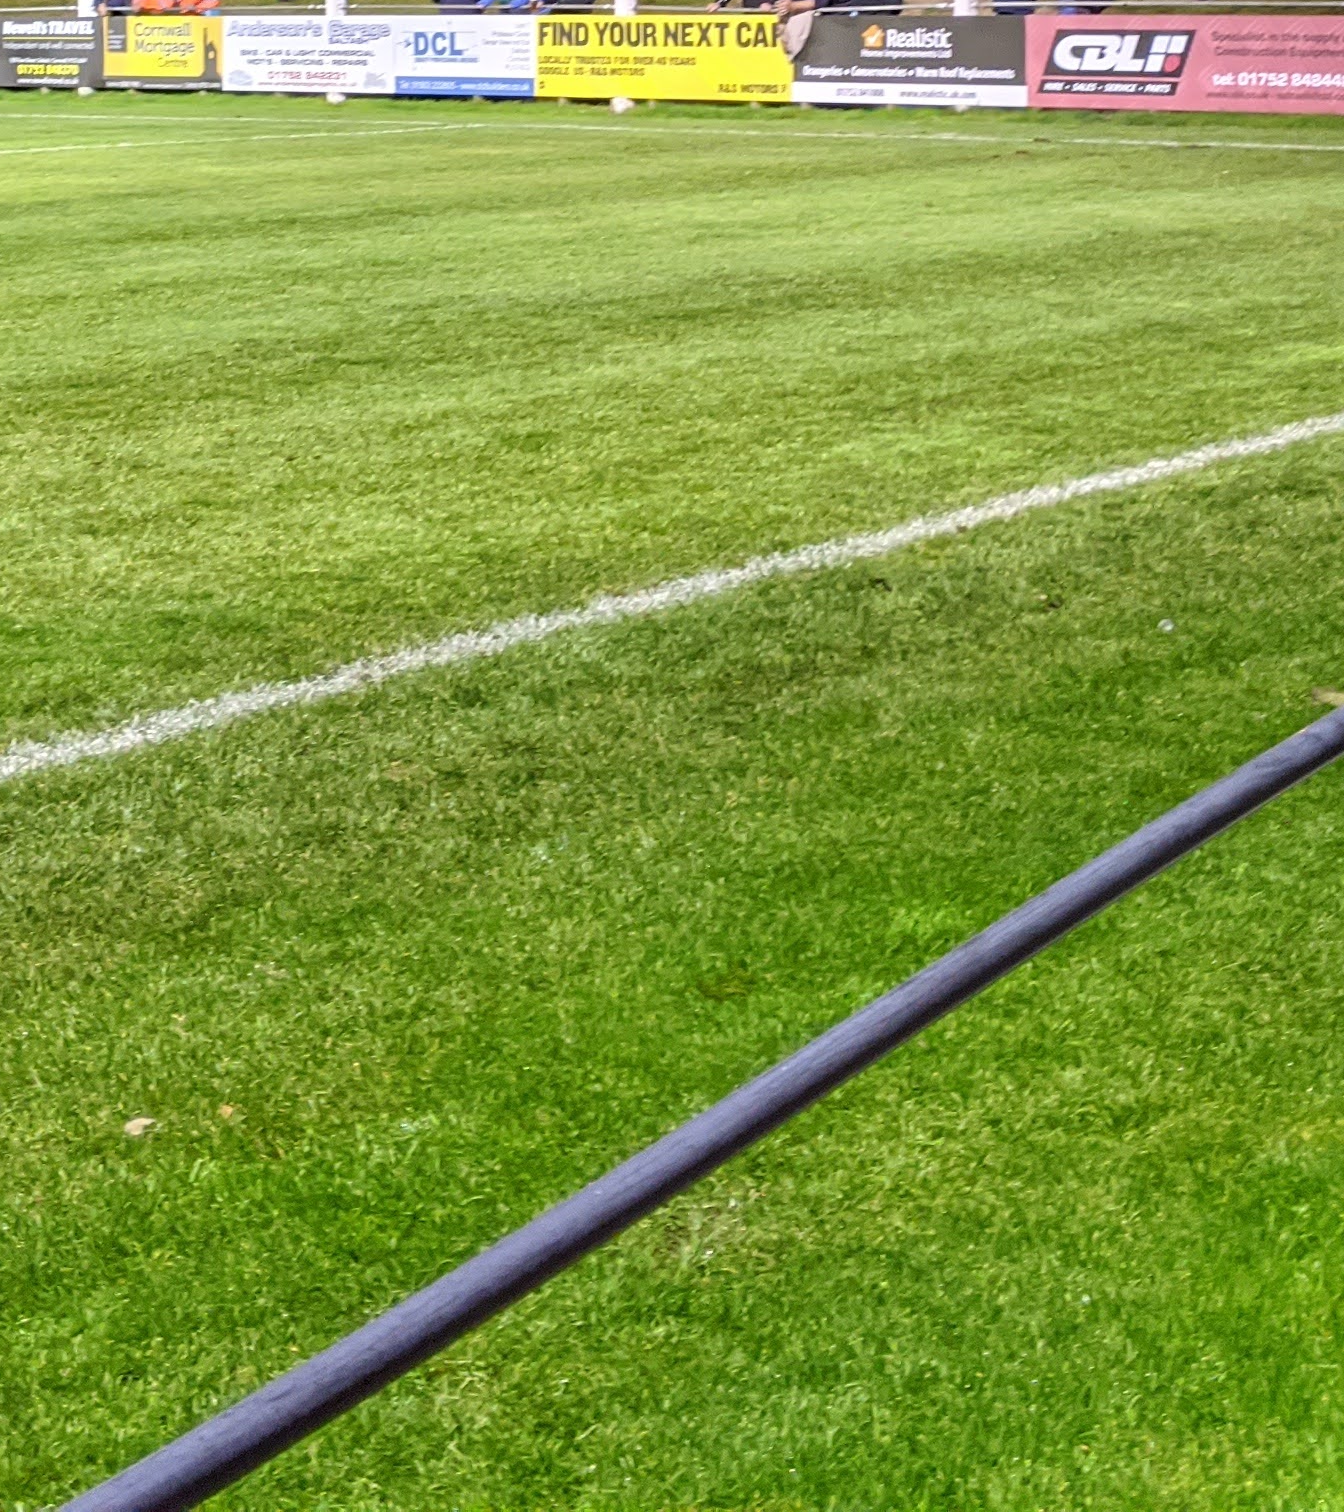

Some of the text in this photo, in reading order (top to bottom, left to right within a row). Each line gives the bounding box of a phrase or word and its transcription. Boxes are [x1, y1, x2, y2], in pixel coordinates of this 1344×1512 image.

[48, 20, 95, 35] TRAVEL
[134, 21, 192, 37] Cornwall
[227, 19, 391, 38] Anderson's Garage
[538, 21, 589, 47] FIND
[595, 21, 657, 47] YOUR
[663, 21, 730, 48] NEXT
[413, 31, 464, 56] DCL
[885, 27, 953, 49] Realistic
[135, 39, 195, 56] Mortgage
[1237, 71, 1289, 86] 01752
